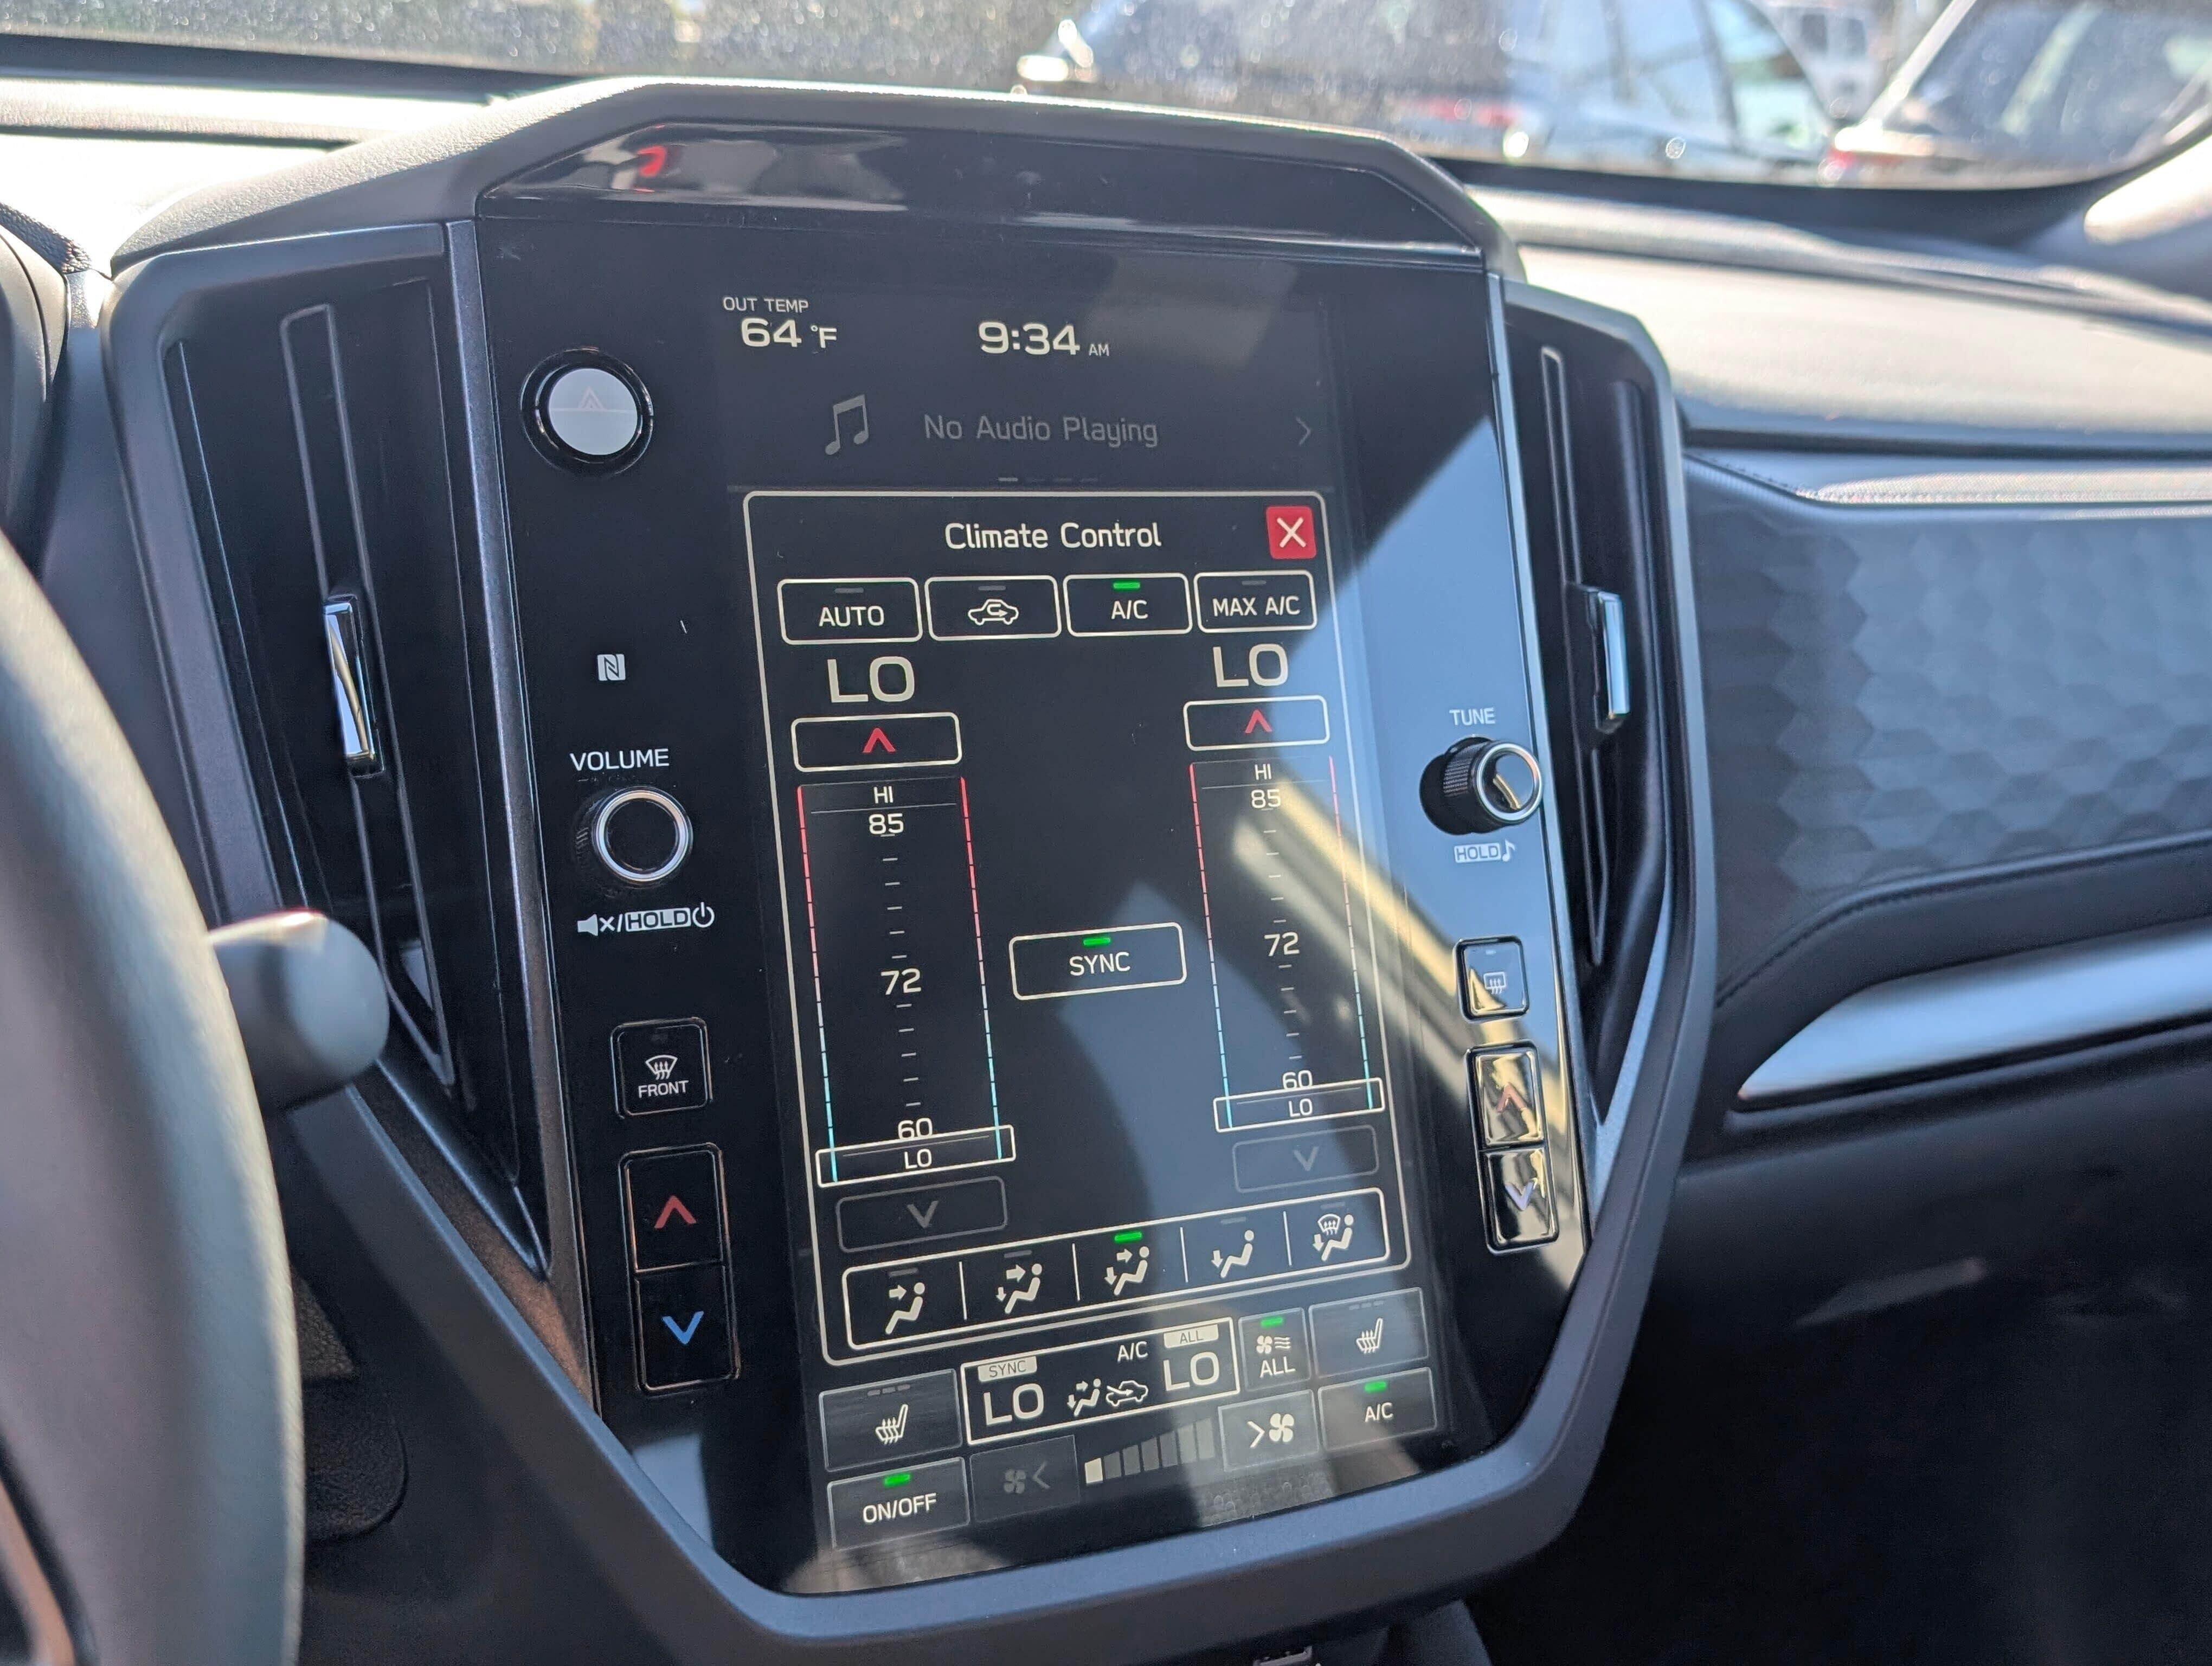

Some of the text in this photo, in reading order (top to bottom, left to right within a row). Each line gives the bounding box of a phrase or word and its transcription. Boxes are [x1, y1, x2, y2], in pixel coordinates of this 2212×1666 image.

[723, 296, 809, 313] OUT TEMP
[741, 317, 802, 348] 64
[978, 321, 1110, 357] 9:34 AM
[924, 414, 1159, 448] No Audio Playing
[944, 522, 1162, 549] Climate Control
[818, 605, 885, 627] AUTO
[1111, 600, 1148, 620] A/C
[1212, 595, 1300, 618] MAX A/C
[1212, 643, 1288, 688] LO
[827, 656, 915, 703] LO
[1449, 707, 1496, 726] TUNE
[569, 748, 670, 771] VOLUME
[1255, 764, 1271, 780] HI
[873, 785, 893, 804] HI
[1251, 789, 1281, 809] 85
[869, 813, 904, 835] 85
[1456, 845, 1499, 861] HOLD
[1264, 932, 1300, 957] 72
[1069, 952, 1131, 976] SYNC
[880, 968, 922, 995] 72
[638, 1080, 689, 1098] FRONT
[1282, 1070, 1313, 1090] 60
[1289, 1099, 1313, 1118] LO
[897, 1118, 933, 1140] 60
[904, 1149, 932, 1170] LO
[1179, 1330, 1204, 1344] ALL
[1117, 1341, 1148, 1362] A/C
[988, 1359, 1026, 1378] SYNC
[1163, 1351, 1219, 1392] LO
[1259, 1356, 1296, 1378] ALL
[983, 1383, 1044, 1426] LO
[1364, 1402, 1393, 1422] A/C
[863, 1492, 937, 1523] ON/OFF
